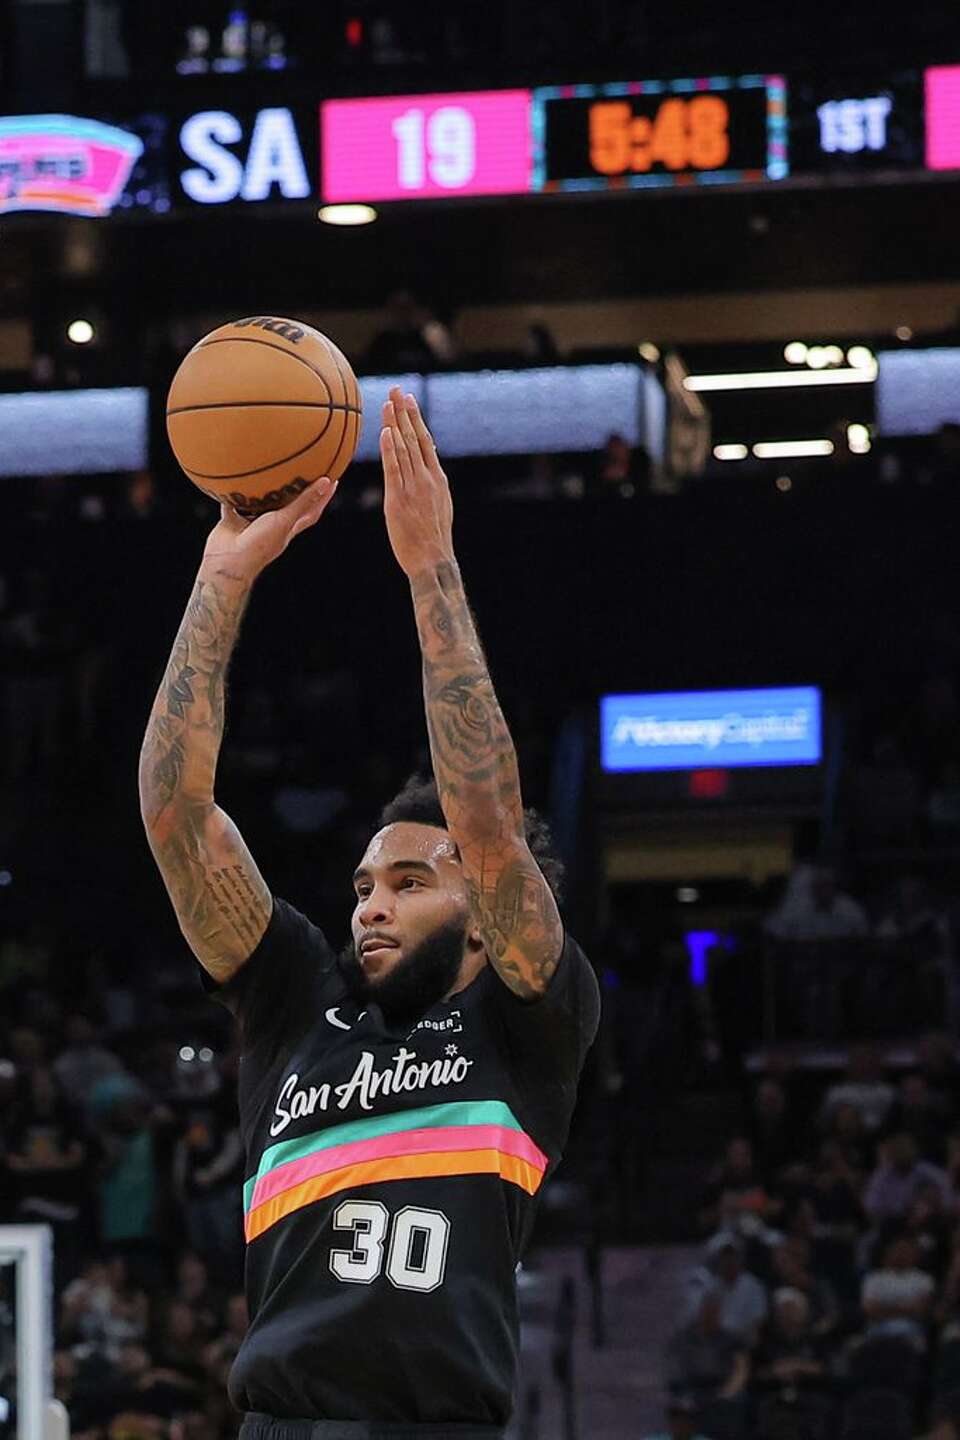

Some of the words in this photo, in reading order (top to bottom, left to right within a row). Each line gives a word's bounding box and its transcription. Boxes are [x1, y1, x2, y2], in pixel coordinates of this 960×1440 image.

[180, 107, 310, 203] SA
[392, 106, 475, 189] 19
[589, 95, 730, 174] 5:48
[817, 95, 892, 153] 1ST
[269, 1074, 331, 1137] San
[334, 1046, 473, 1111] Antonio
[328, 1199, 452, 1293] 30
